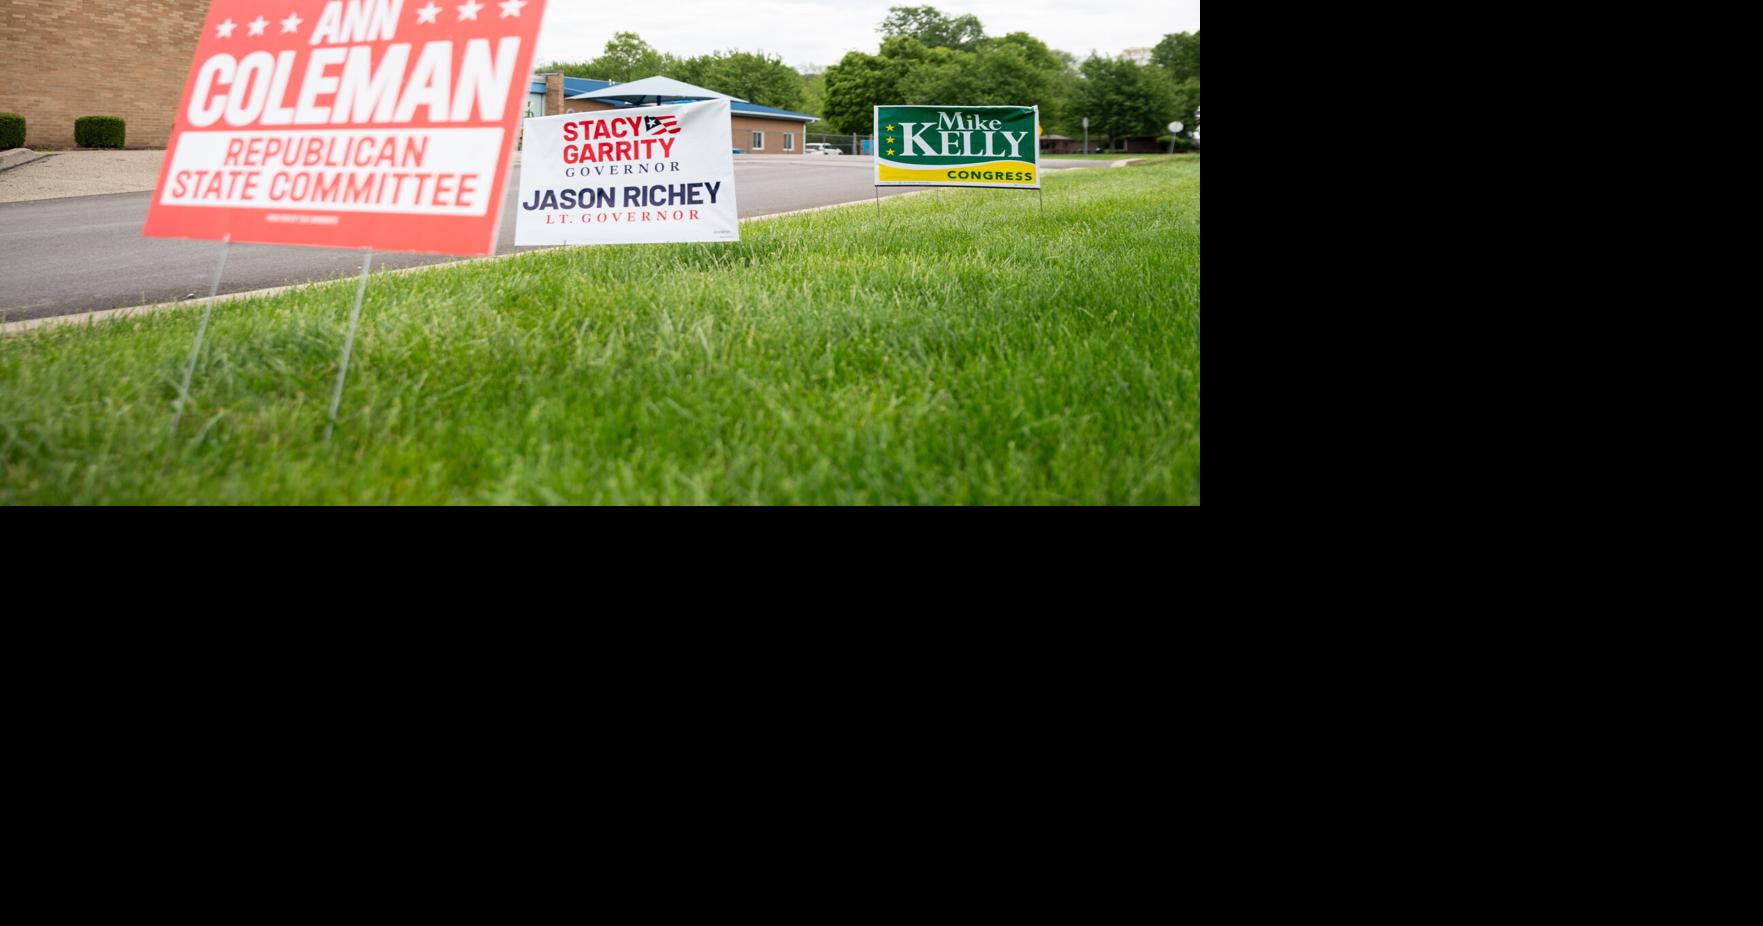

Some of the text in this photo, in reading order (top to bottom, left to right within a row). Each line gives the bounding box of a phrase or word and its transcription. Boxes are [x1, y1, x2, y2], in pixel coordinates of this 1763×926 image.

[309, 0, 405, 45] ANN
[187, 36, 521, 127] COLEMAN
[563, 116, 642, 142] STACY
[936, 111, 1002, 131] Mike
[224, 136, 428, 167] REPUBLICAN
[563, 137, 676, 164] GARRITY
[898, 122, 1029, 158] KELLY
[566, 162, 681, 177] GOVERNOR
[947, 170, 1033, 181] CONGRESS
[172, 170, 478, 206] STATE COMMITTEE
[522, 181, 721, 211] JASON RICHEY
[546, 210, 700, 224] LT. GOVERNOR
